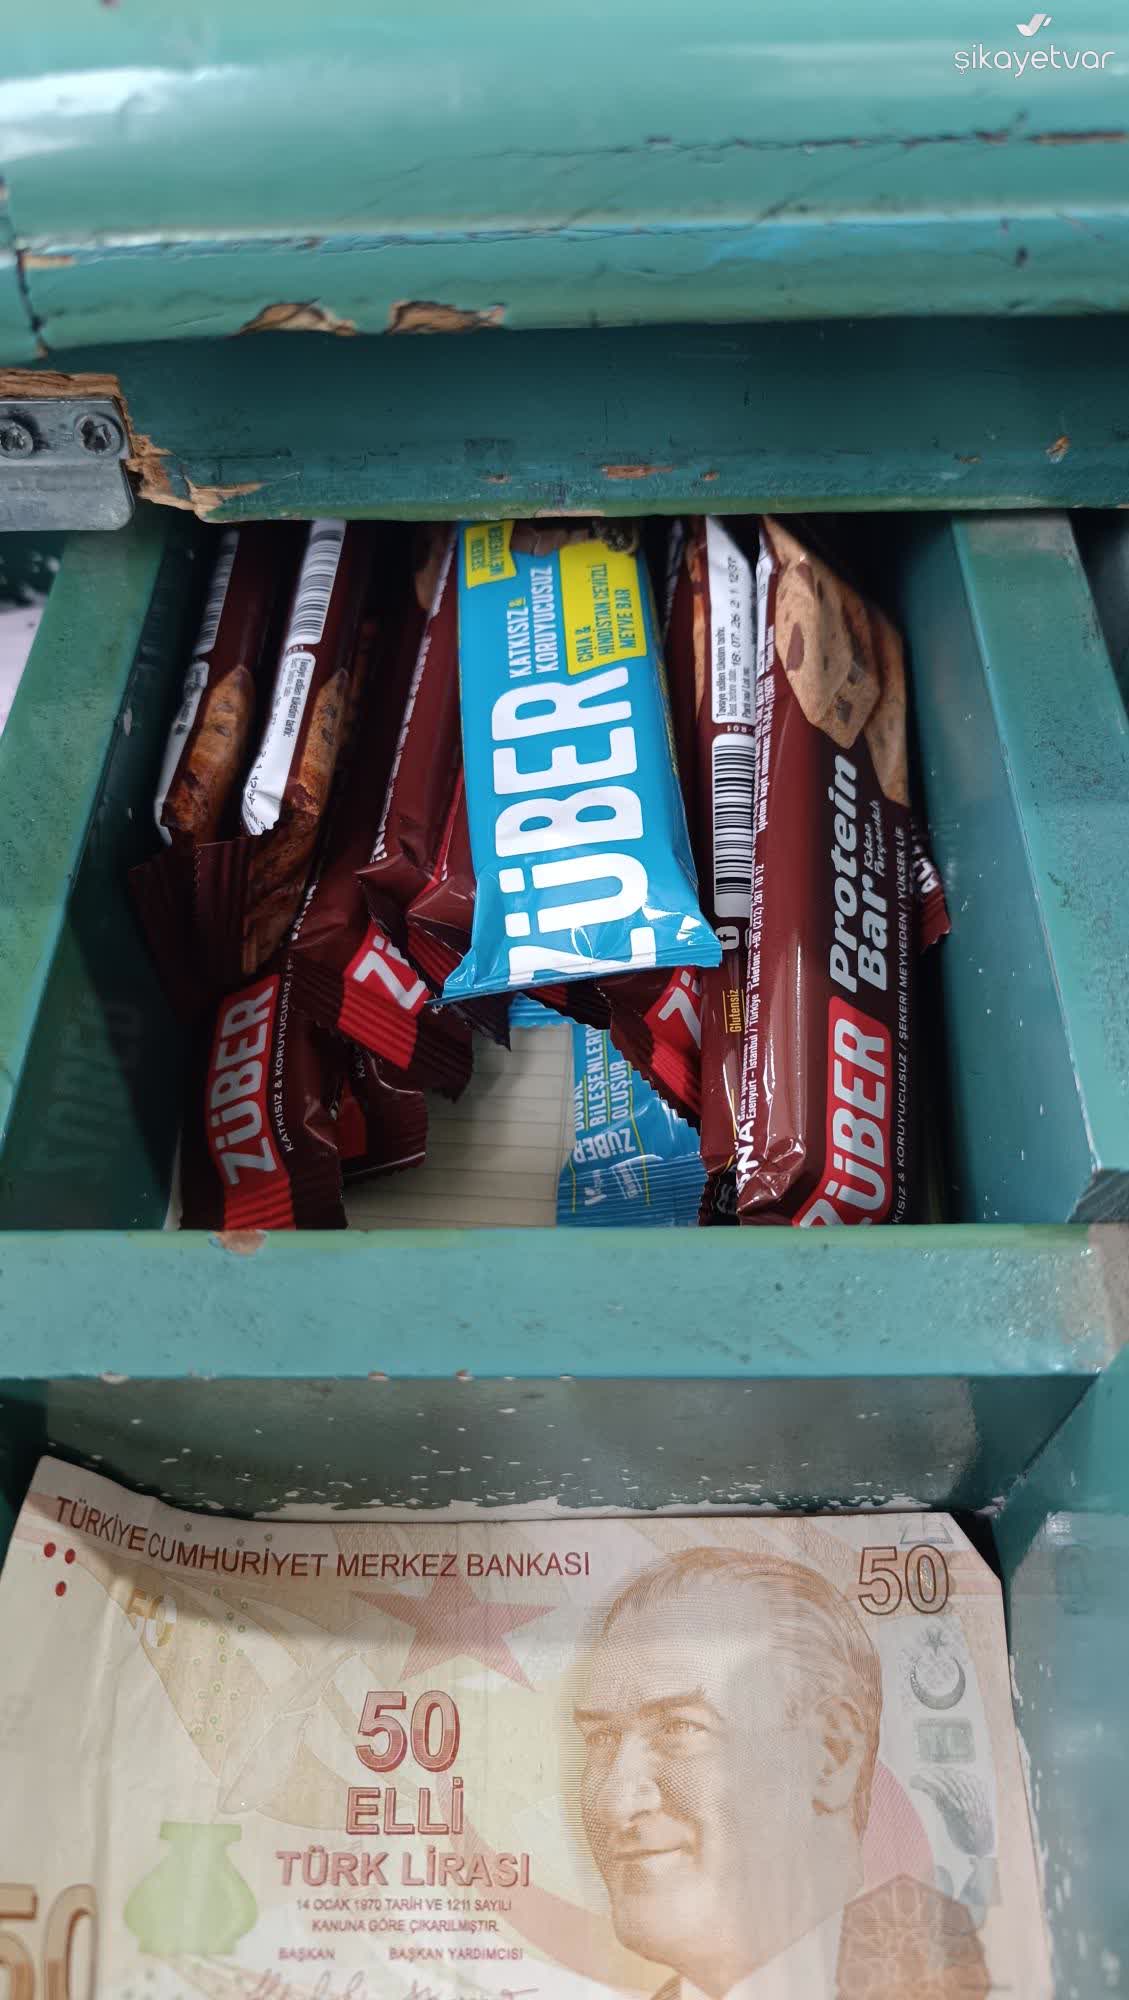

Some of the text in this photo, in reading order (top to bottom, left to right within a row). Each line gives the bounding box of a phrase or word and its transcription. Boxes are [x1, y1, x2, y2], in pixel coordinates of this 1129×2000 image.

[507, 607, 532, 678] KATKISIZ
[530, 566, 559, 673] KORUYUCUSUZ
[575, 625, 591, 634] &
[615, 588, 636, 648] MEYVE BAR
[492, 666, 656, 986] ZÜBER
[755, 864, 764, 875] 12
[755, 876, 764, 888] 10
[828, 754, 858, 993] Protein
[895, 850, 907, 900] YÜKSEK
[753, 907, 764, 929] (212)
[857, 874, 888, 991] Bar
[750, 951, 761, 989] Telefon:
[898, 912, 909, 988] MEYVEDEN
[729, 988, 742, 1032] Glutensiz
[748, 994, 761, 1025] Türkiye
[898, 992, 912, 1040] ŞEKERİ
[210, 986, 277, 1185] ZÜBER
[274, 1079, 283, 1089] &
[609, 1060, 633, 1120] OLUŞUR
[746, 1080, 759, 1119] Esenyurt
[273, 1091, 294, 1152] KATKISIZ
[897, 1052, 908, 1168] KORUYUCUSUZ
[573, 1127, 636, 1164] ZÜBER
[57, 1496, 590, 1577] TÜRKİYE CUMHURİYET MERKEZ BANKASI
[857, 1544, 950, 1615] 50
[355, 1689, 461, 1773] 50
[345, 1776, 465, 1835] ELLİ
[276, 1845, 530, 1888] TÜRK LİRASI
[312, 1920, 366, 1932] KANUNA
[369, 1918, 404, 1932] GÖRE
[313, 1900, 350, 1911] OCAK
[354, 1900, 382, 1911] 1970
[384, 1896, 423, 1911] TARİH
[426, 1900, 443, 1911] VE
[447, 1900, 470, 1911] 1211
[475, 1900, 512, 1911] SAYILI
[278, 1947, 336, 1962] BAŞKAN
[389, 1947, 524, 1963] BAŞKAN YARDIMCISI
